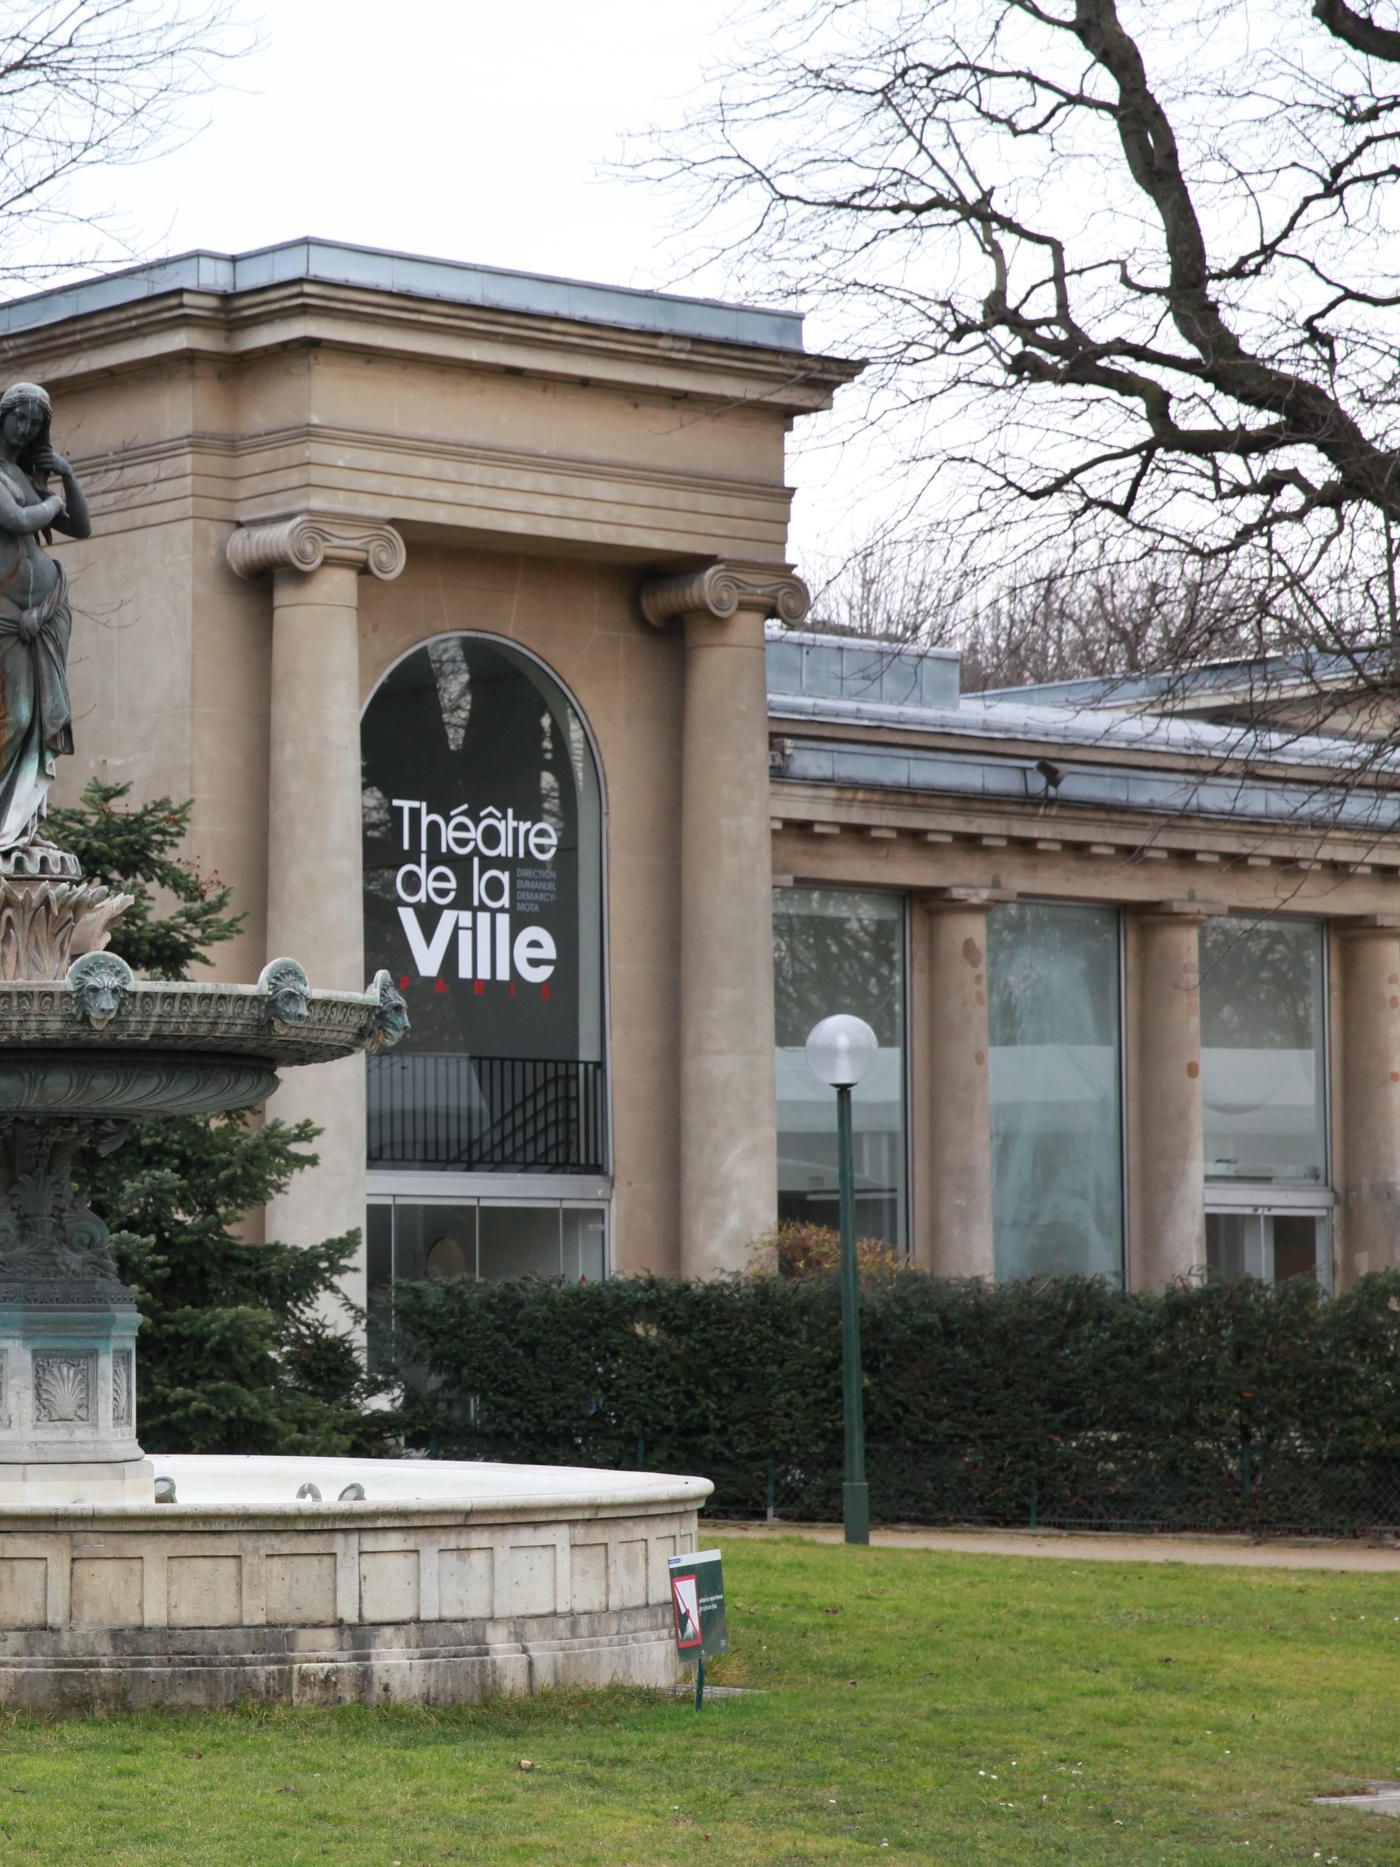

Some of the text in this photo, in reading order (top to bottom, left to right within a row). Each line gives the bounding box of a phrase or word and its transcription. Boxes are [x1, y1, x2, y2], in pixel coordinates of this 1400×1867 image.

[392, 799, 558, 861] Théâtre
[396, 853, 510, 909] de la
[516, 868, 557, 879] DIRECTION
[516, 879, 556, 891] EMMANUEL
[516, 901, 540, 912] MOTA
[397, 906, 557, 983] Ville
[399, 976, 551, 1000] PARIS
